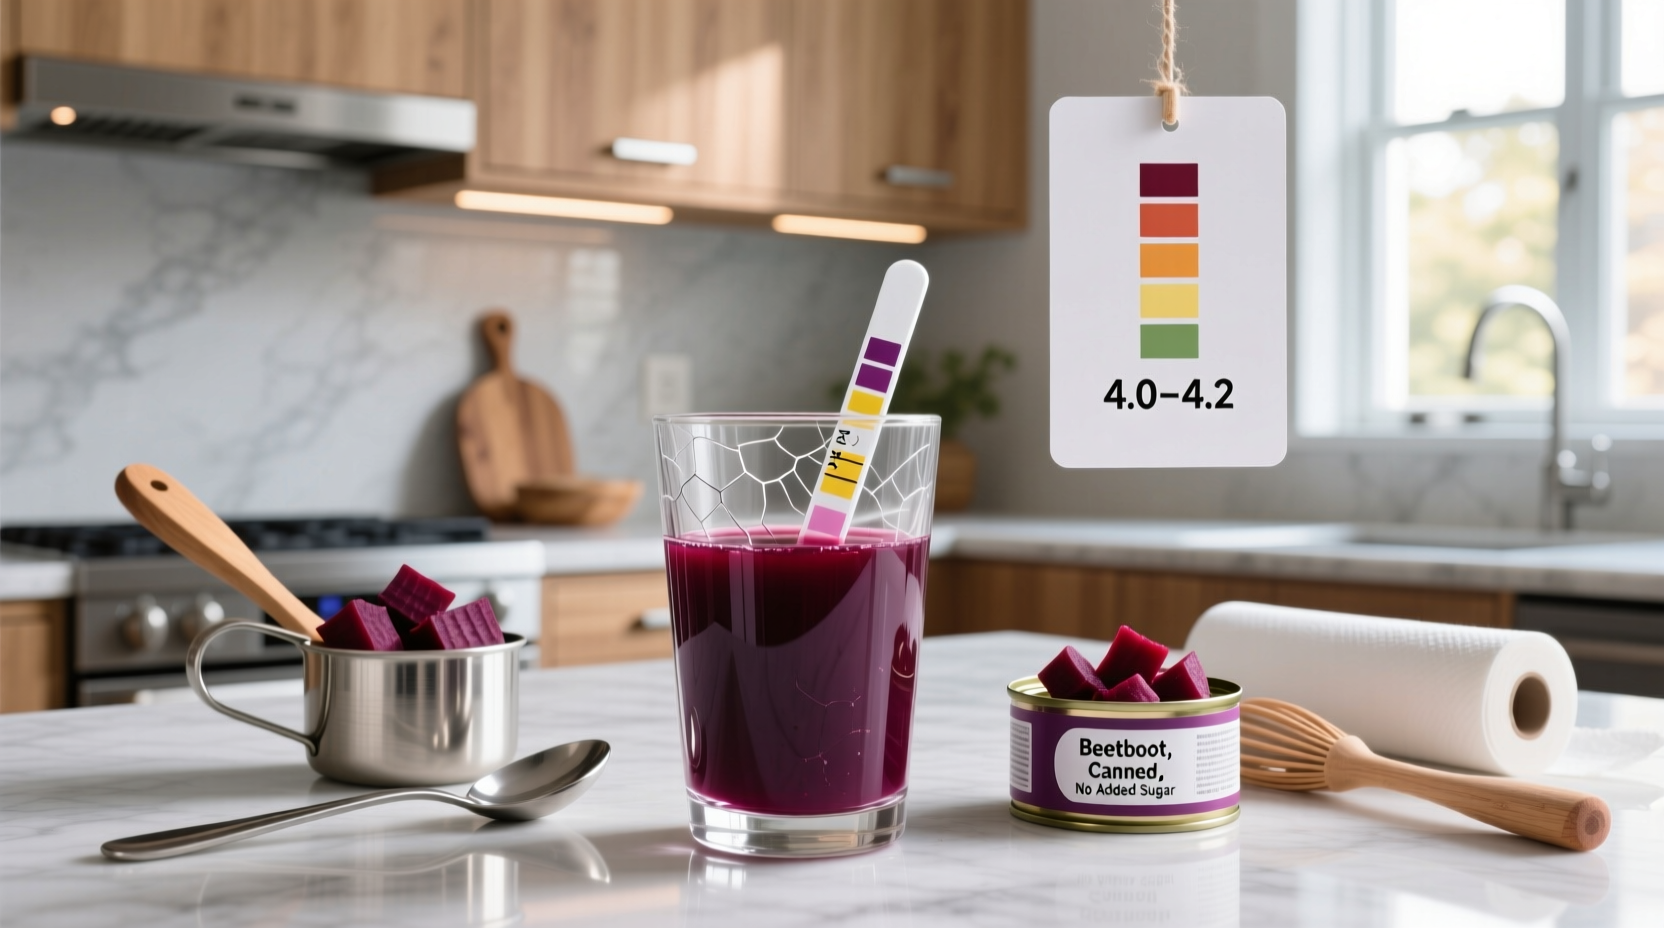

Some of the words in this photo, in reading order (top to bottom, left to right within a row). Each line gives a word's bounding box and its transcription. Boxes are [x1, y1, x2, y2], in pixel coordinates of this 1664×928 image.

[1079, 737, 1172, 761] Beetboot,
[1088, 761, 1164, 782] Canned,
[1075, 781, 1092, 796] No
[1095, 782, 1136, 797] Added
[1140, 783, 1176, 800] Sugar
